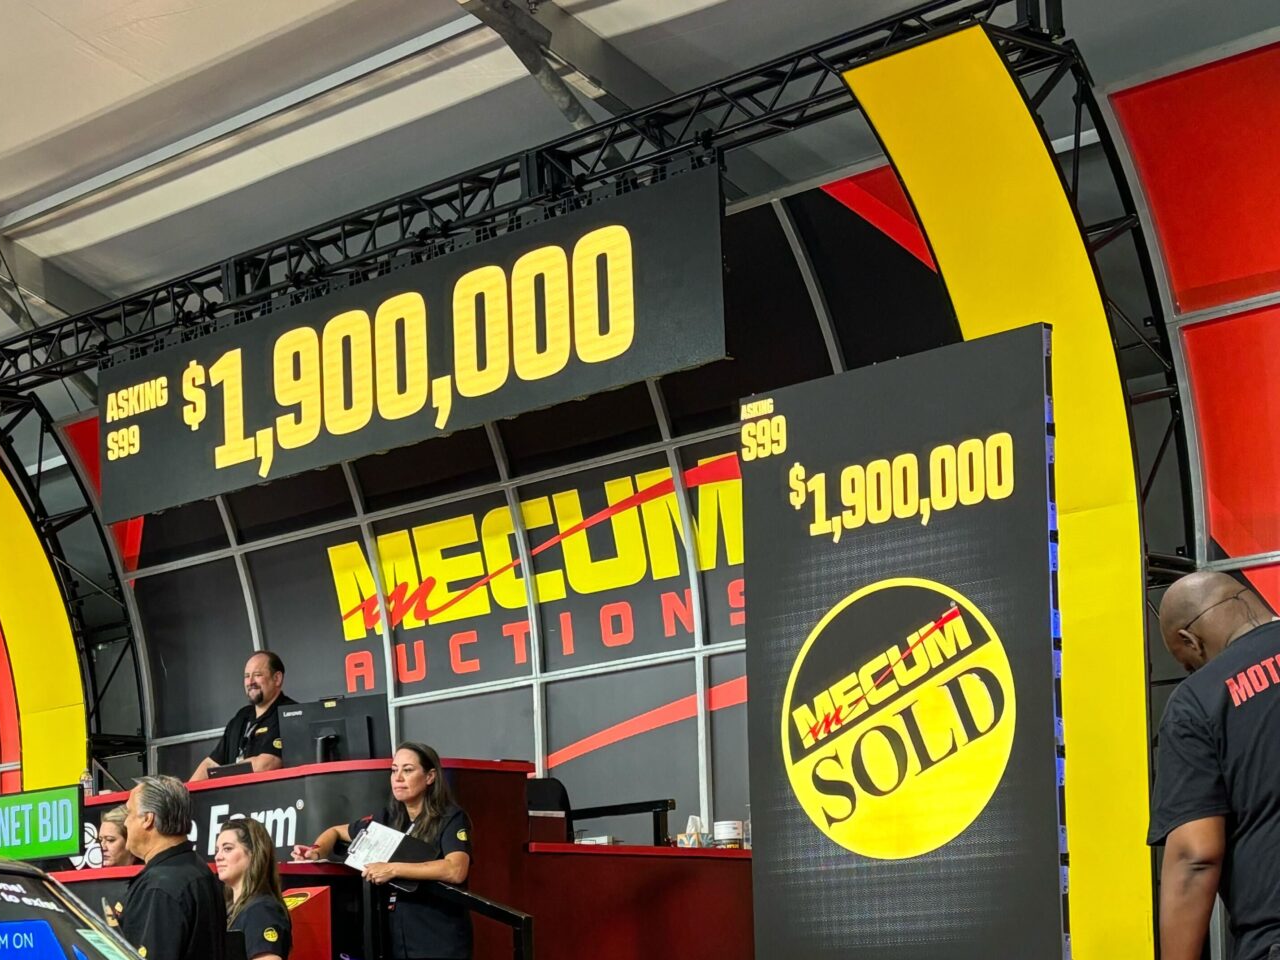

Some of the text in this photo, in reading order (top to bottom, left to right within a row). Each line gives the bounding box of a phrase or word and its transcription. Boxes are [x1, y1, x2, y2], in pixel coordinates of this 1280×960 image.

[182, 225, 635, 478] $1,900,000
[105, 376, 168, 423] ASKING
[107, 425, 141, 461] S99
[741, 415, 787, 462] S99
[789, 432, 1015, 544] $1,900,000
[327, 452, 745, 642] MECUM
[792, 606, 973, 750] MECUM
[811, 666, 1006, 830] SOLD
[38, 798, 74, 843] BID
[1, 890, 21, 903] to
[12, 932, 34, 949] ON
